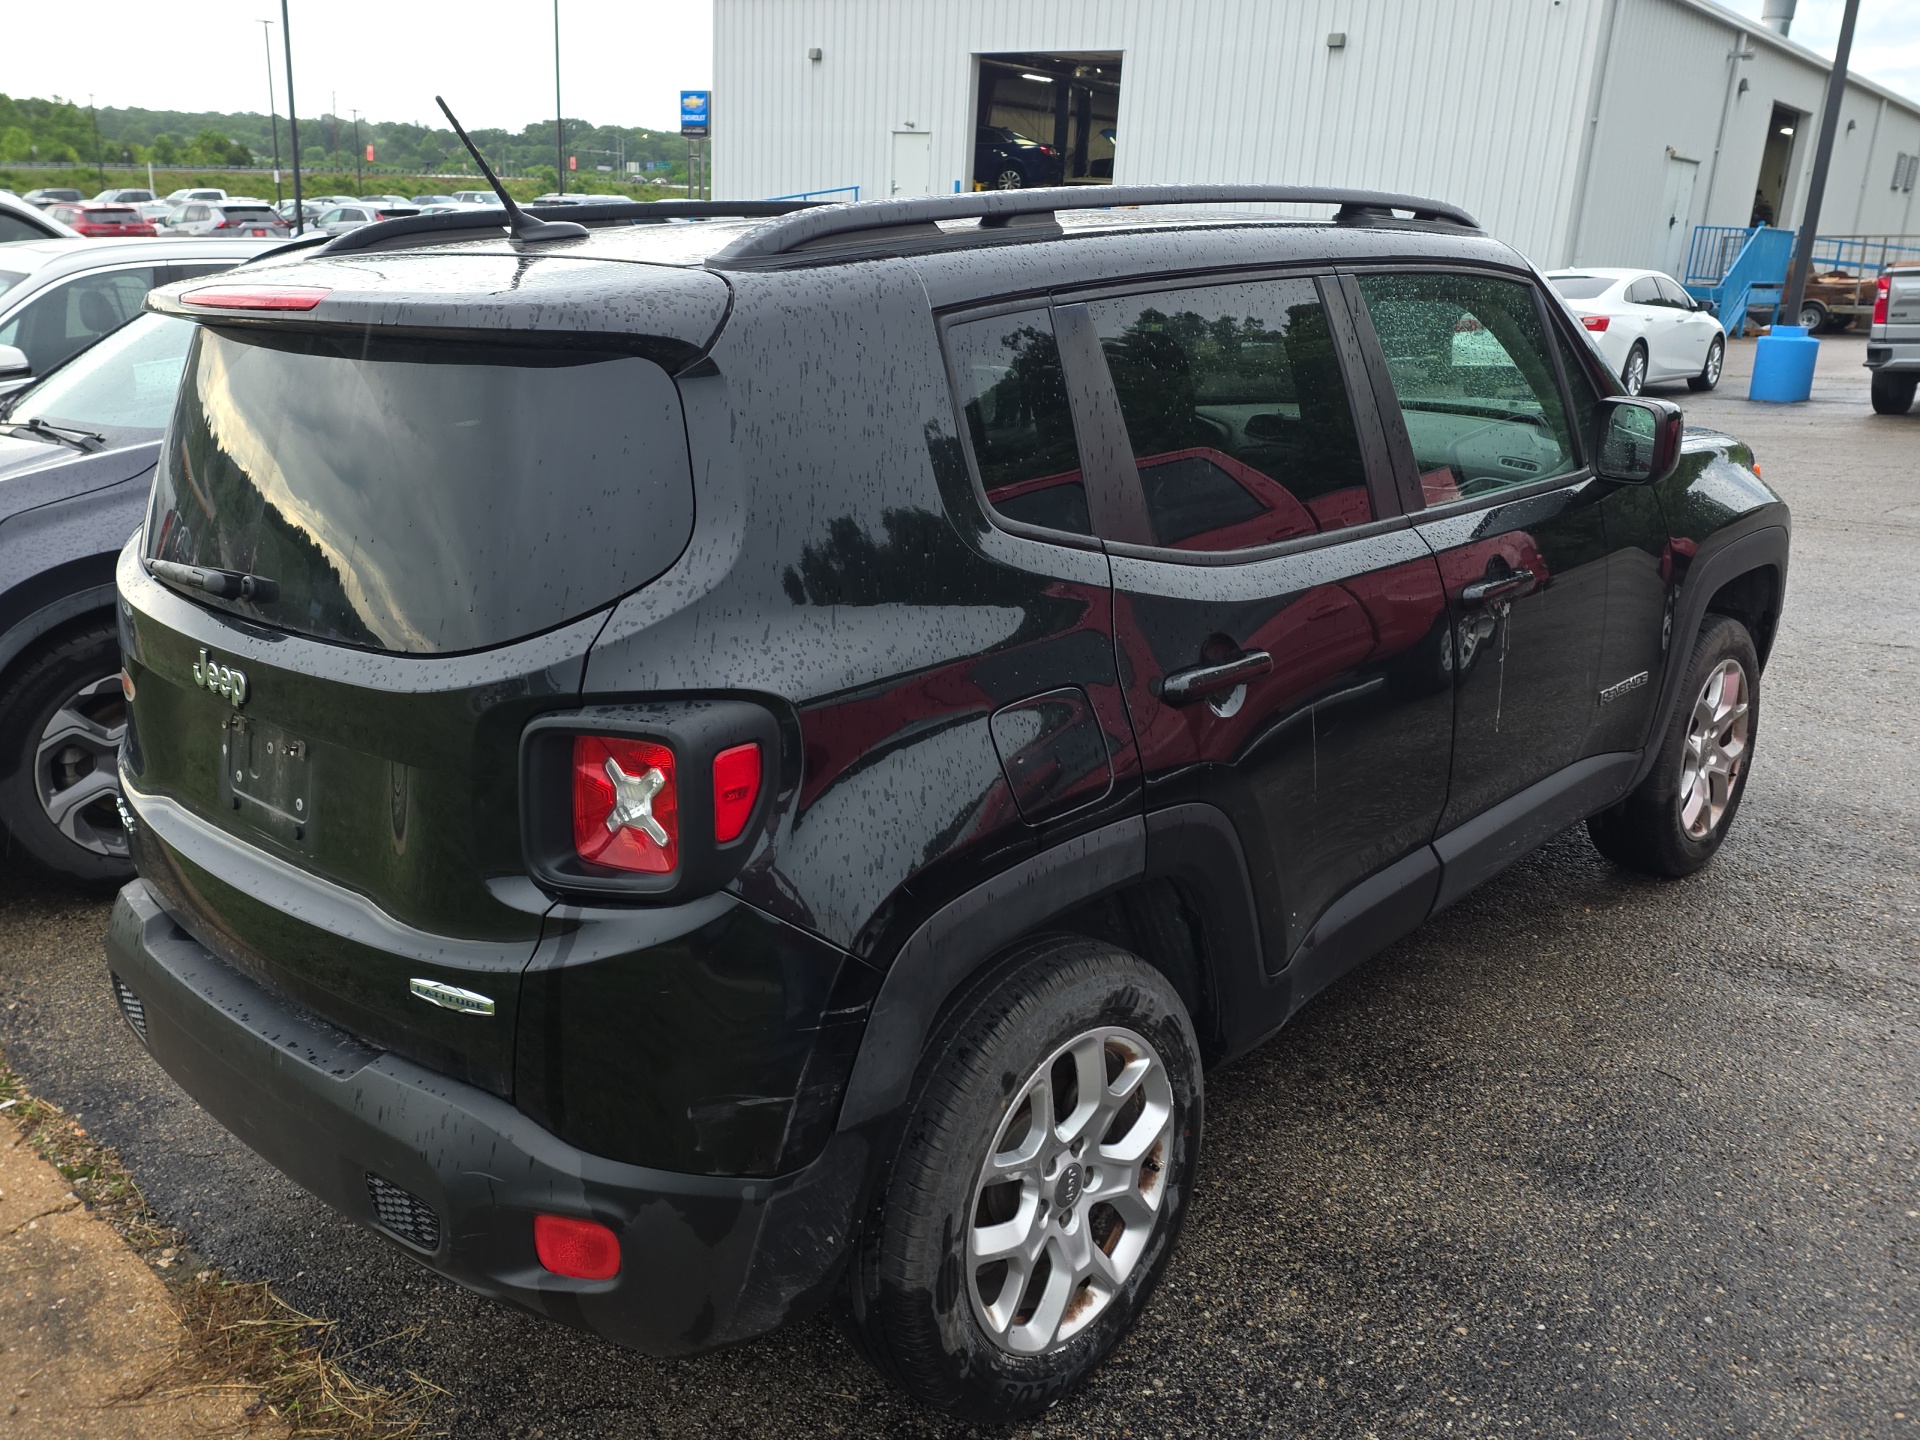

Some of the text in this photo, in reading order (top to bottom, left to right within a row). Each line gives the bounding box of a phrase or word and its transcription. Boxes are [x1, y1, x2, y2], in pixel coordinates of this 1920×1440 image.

[193, 647, 247, 707] Jeep
[1600, 670, 1648, 705] RENEGADE
[415, 985, 485, 1012] LATITUDE
